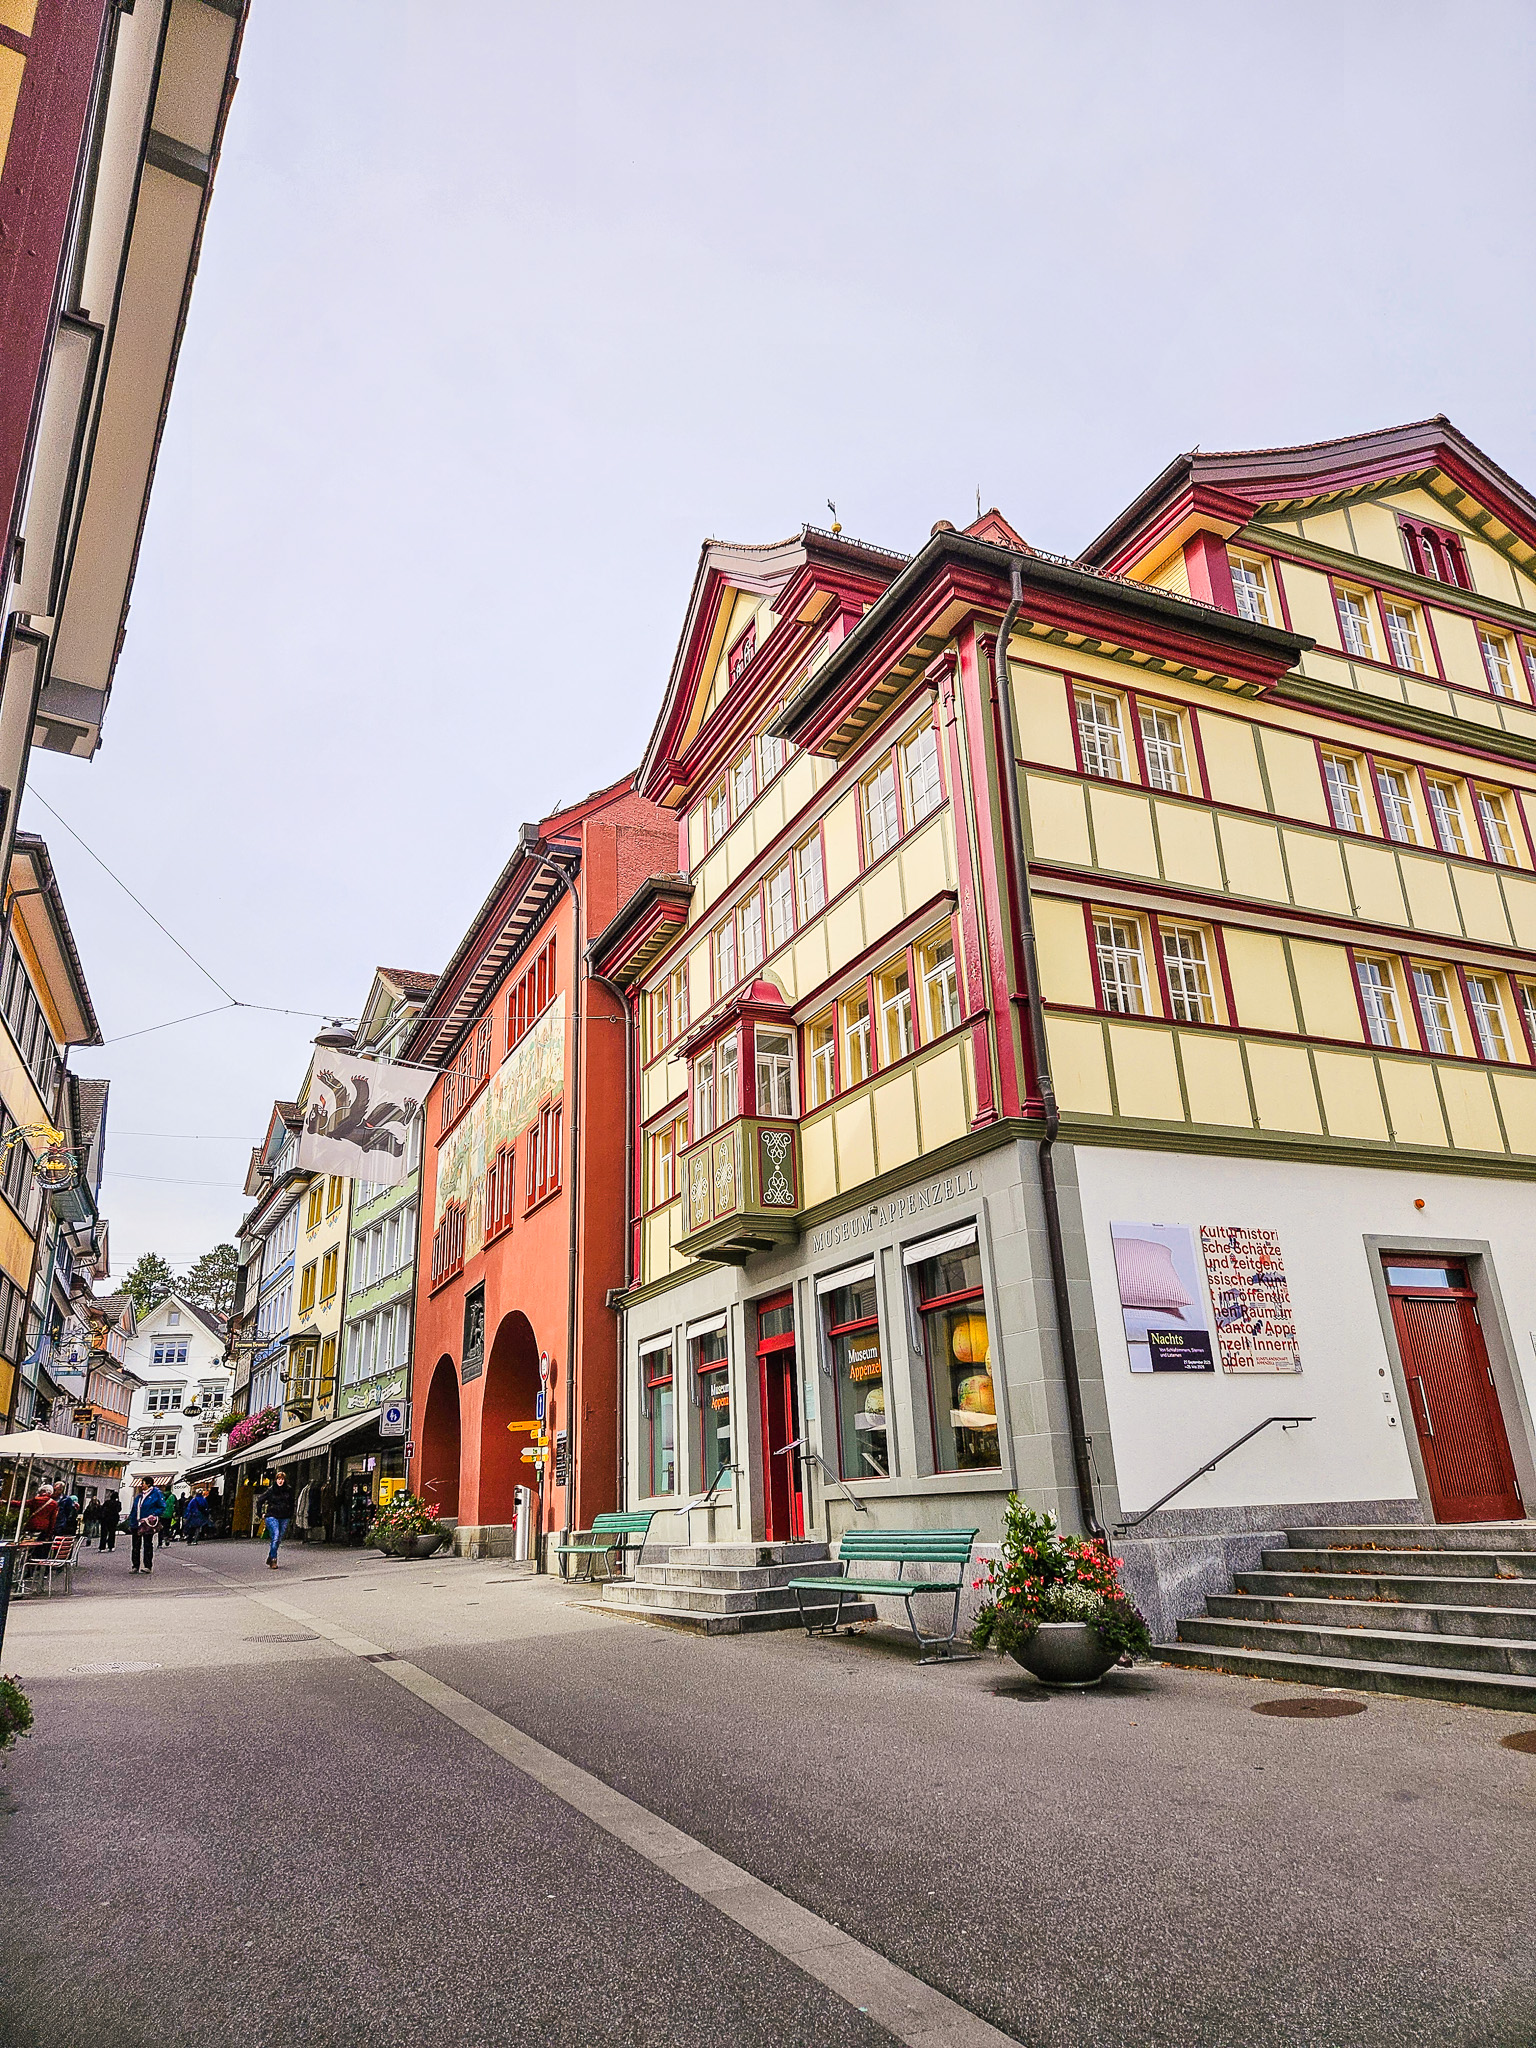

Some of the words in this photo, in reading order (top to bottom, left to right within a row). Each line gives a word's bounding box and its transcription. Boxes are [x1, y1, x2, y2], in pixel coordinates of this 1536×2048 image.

[813, 1211, 873, 1254] MUSEUM
[879, 1169, 978, 1228] APPENZELL
[1200, 1225, 1279, 1241] Kulturhistori
[1202, 1240, 1231, 1254] sche
[1234, 1241, 1282, 1256] Schätze
[1205, 1255, 1229, 1269] und
[1208, 1271, 1254, 1286] ssische
[1219, 1287, 1235, 1300] im
[1240, 1304, 1276, 1318] Raum
[1216, 1320, 1261, 1334] Kanton
[1265, 1321, 1297, 1338] Appe
[1151, 1332, 1184, 1346] Nachts
[1219, 1336, 1250, 1351] nzell
[1253, 1336, 1300, 1351] Innerrh
[847, 1346, 878, 1365] Museum
[1222, 1353, 1255, 1367] oden
